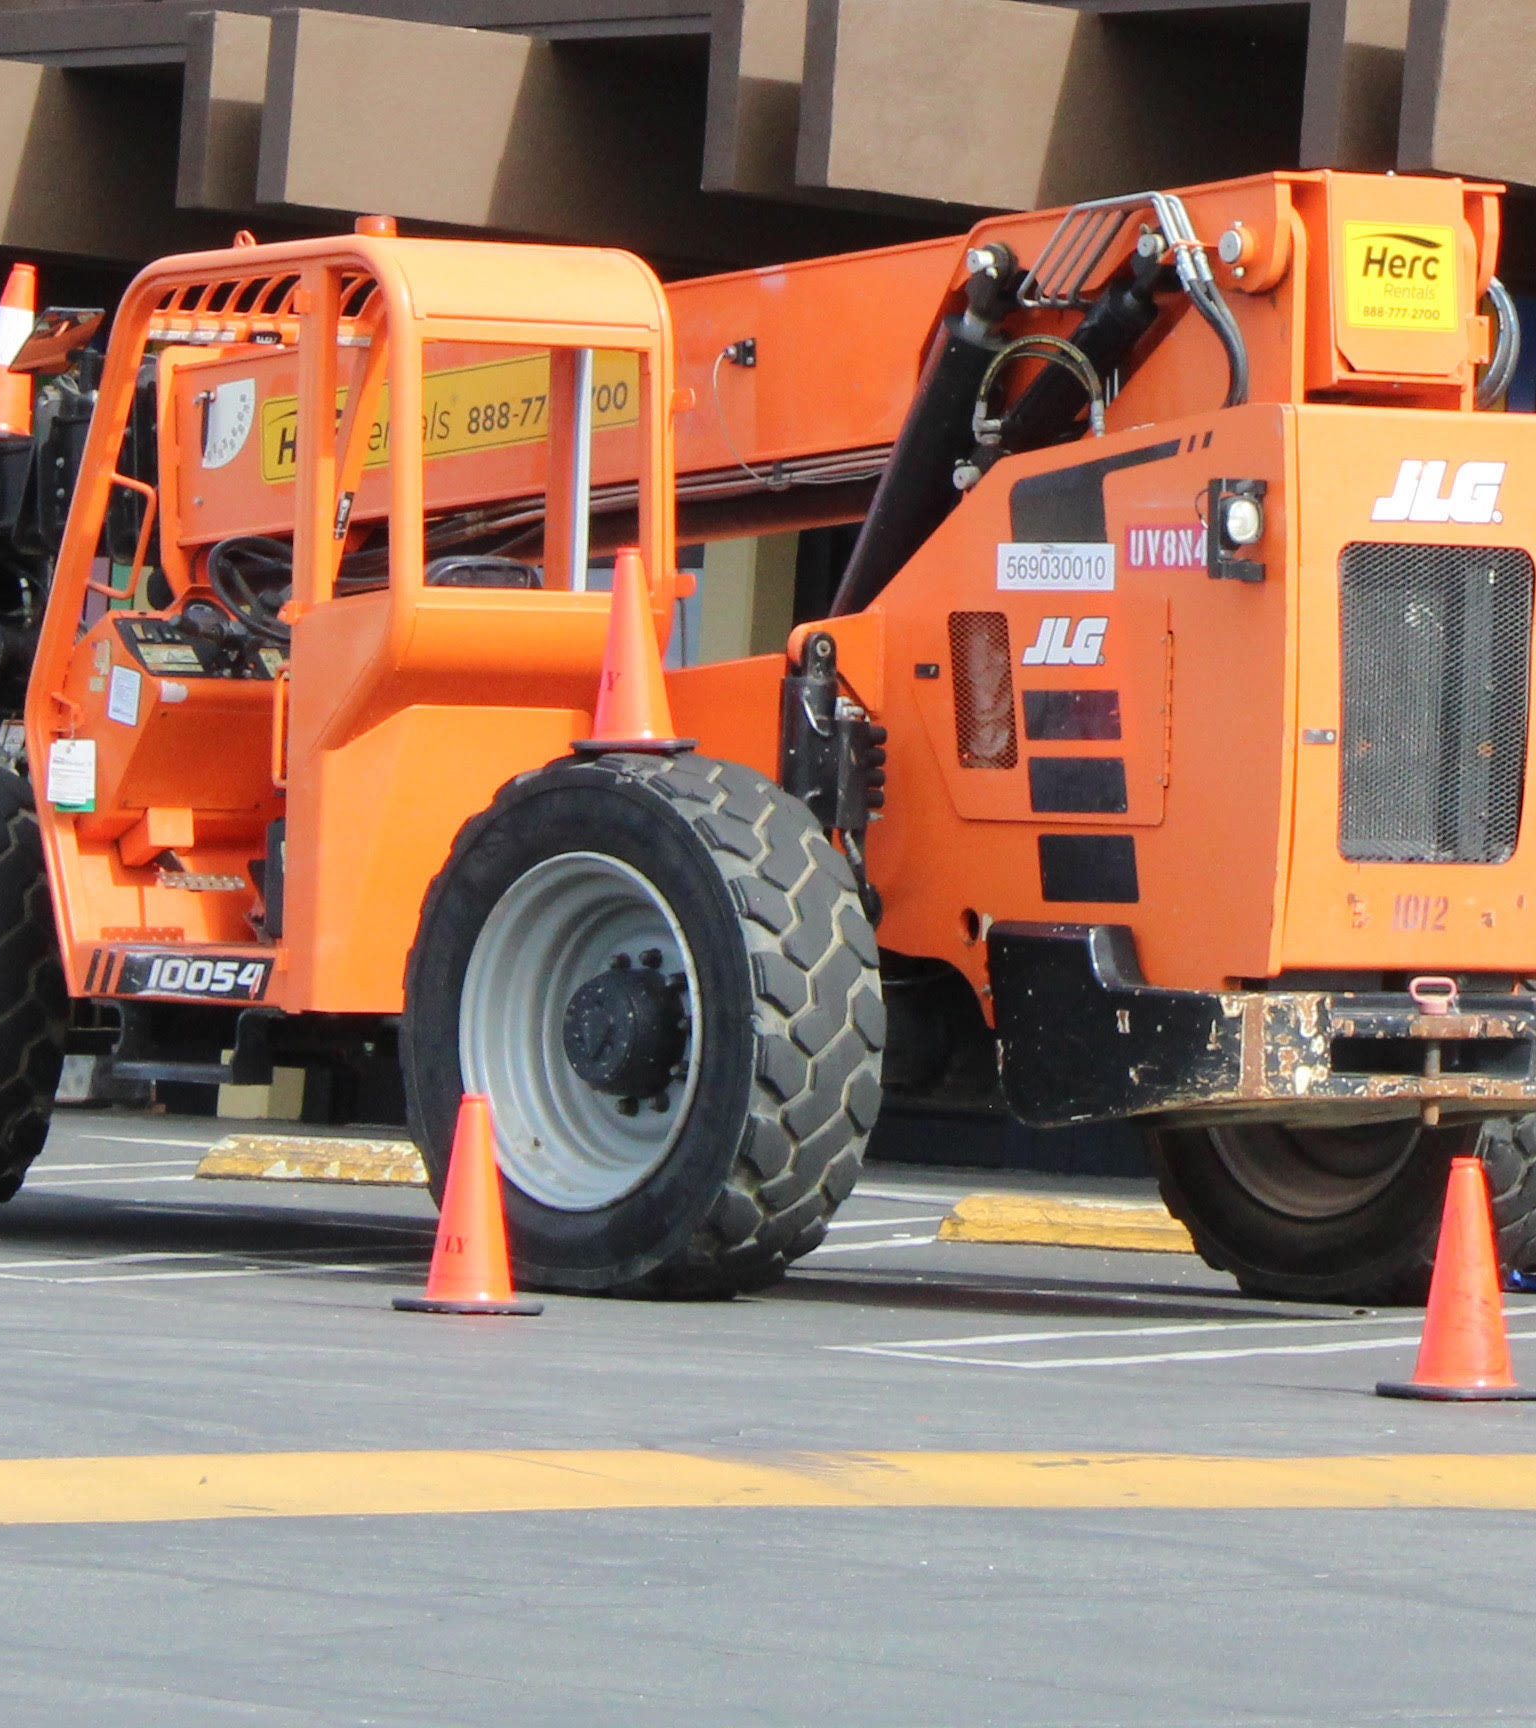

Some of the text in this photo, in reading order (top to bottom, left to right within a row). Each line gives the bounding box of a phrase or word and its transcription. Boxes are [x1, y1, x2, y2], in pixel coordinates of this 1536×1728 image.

[1362, 245, 1441, 281] Herc
[1384, 283, 1436, 301] Rentals
[1362, 305, 1441, 321] 888-777-2700
[467, 380, 629, 434] 888-7700
[1370, 459, 1506, 524] JLG
[1006, 554, 1106, 581] 569030010
[1021, 616, 1109, 666] JLG
[147, 957, 266, 994] 10054
